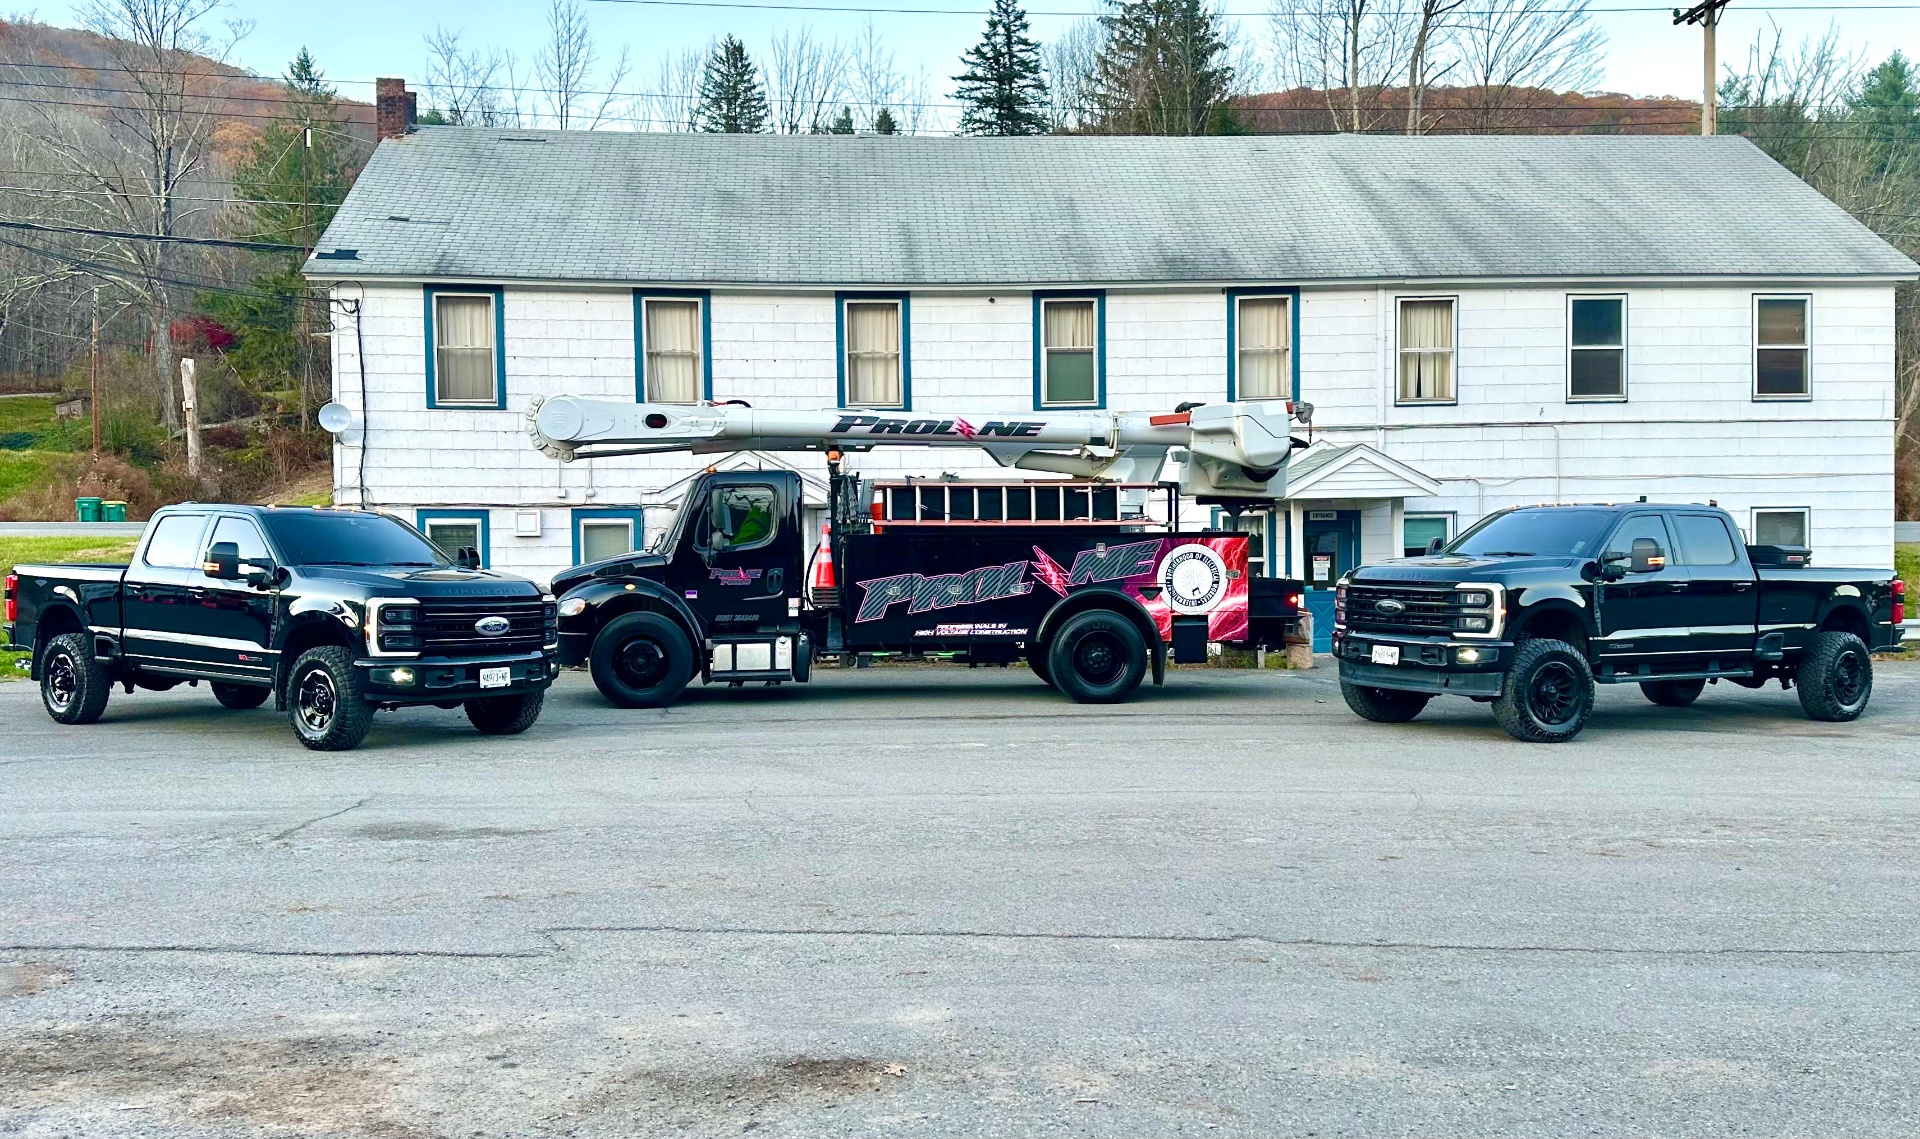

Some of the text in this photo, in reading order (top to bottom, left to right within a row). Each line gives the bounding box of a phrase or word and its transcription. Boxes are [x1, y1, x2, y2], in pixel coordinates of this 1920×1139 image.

[1166, 553, 1194, 580] BROTHERHOOD
[1203, 555, 1220, 582] ELECTRICAL
[1201, 583, 1219, 606] WORKERS
[486, 622, 503, 631] Ford
